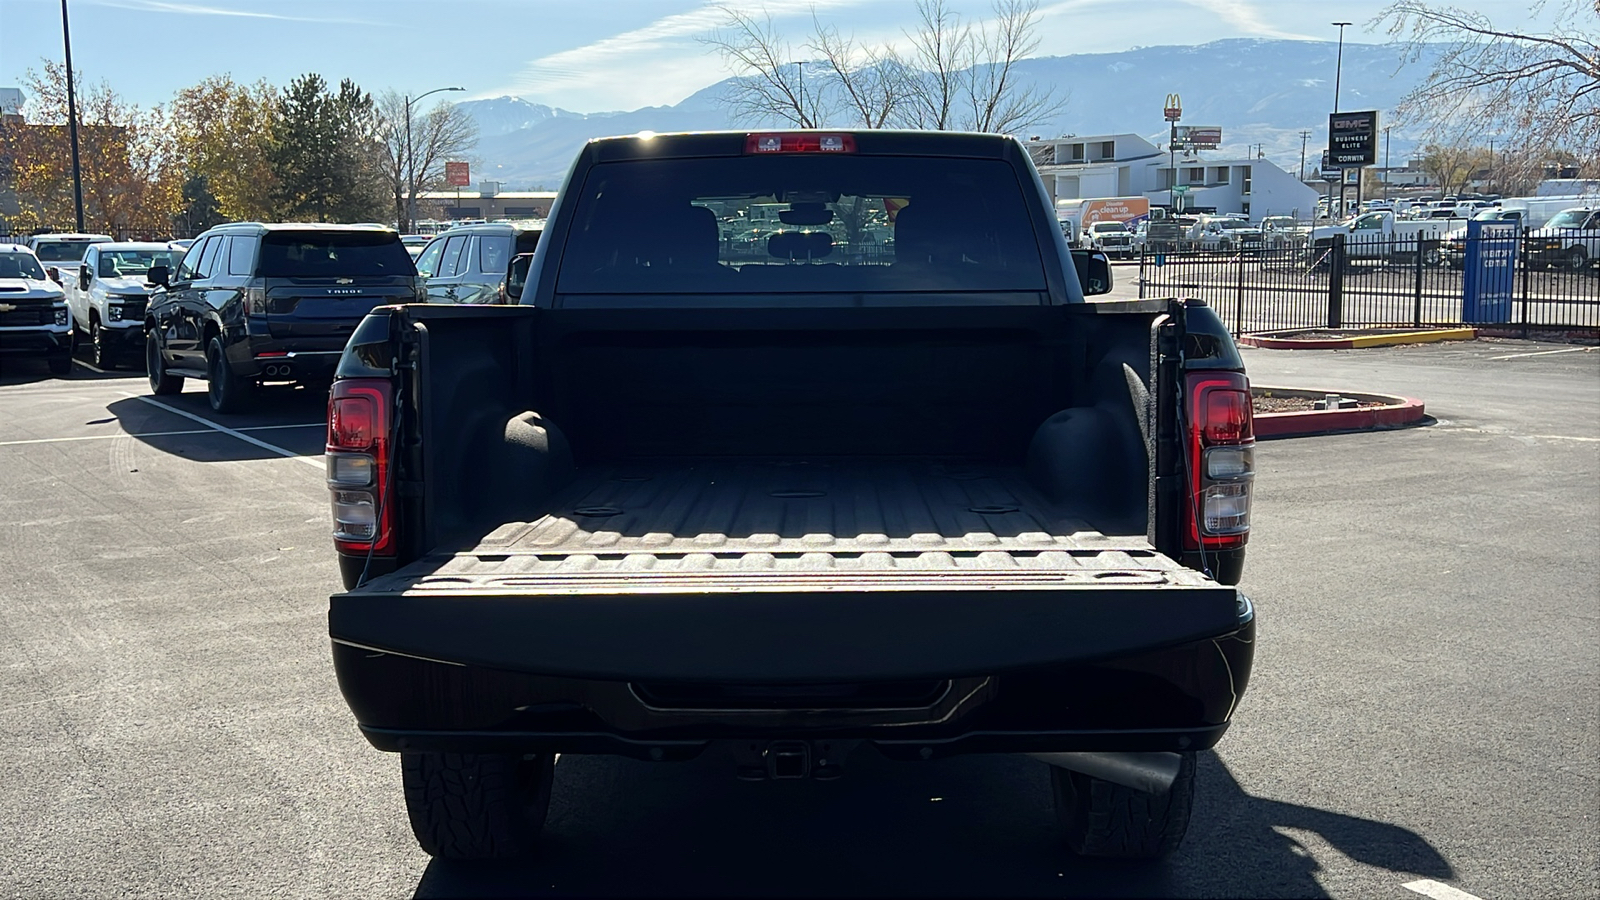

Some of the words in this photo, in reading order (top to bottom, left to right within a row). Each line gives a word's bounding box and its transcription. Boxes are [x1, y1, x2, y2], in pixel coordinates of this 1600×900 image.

[1334, 119, 1370, 129] GMC
[1338, 154, 1364, 162] CORWIN
[1119, 206, 1129, 214] up
